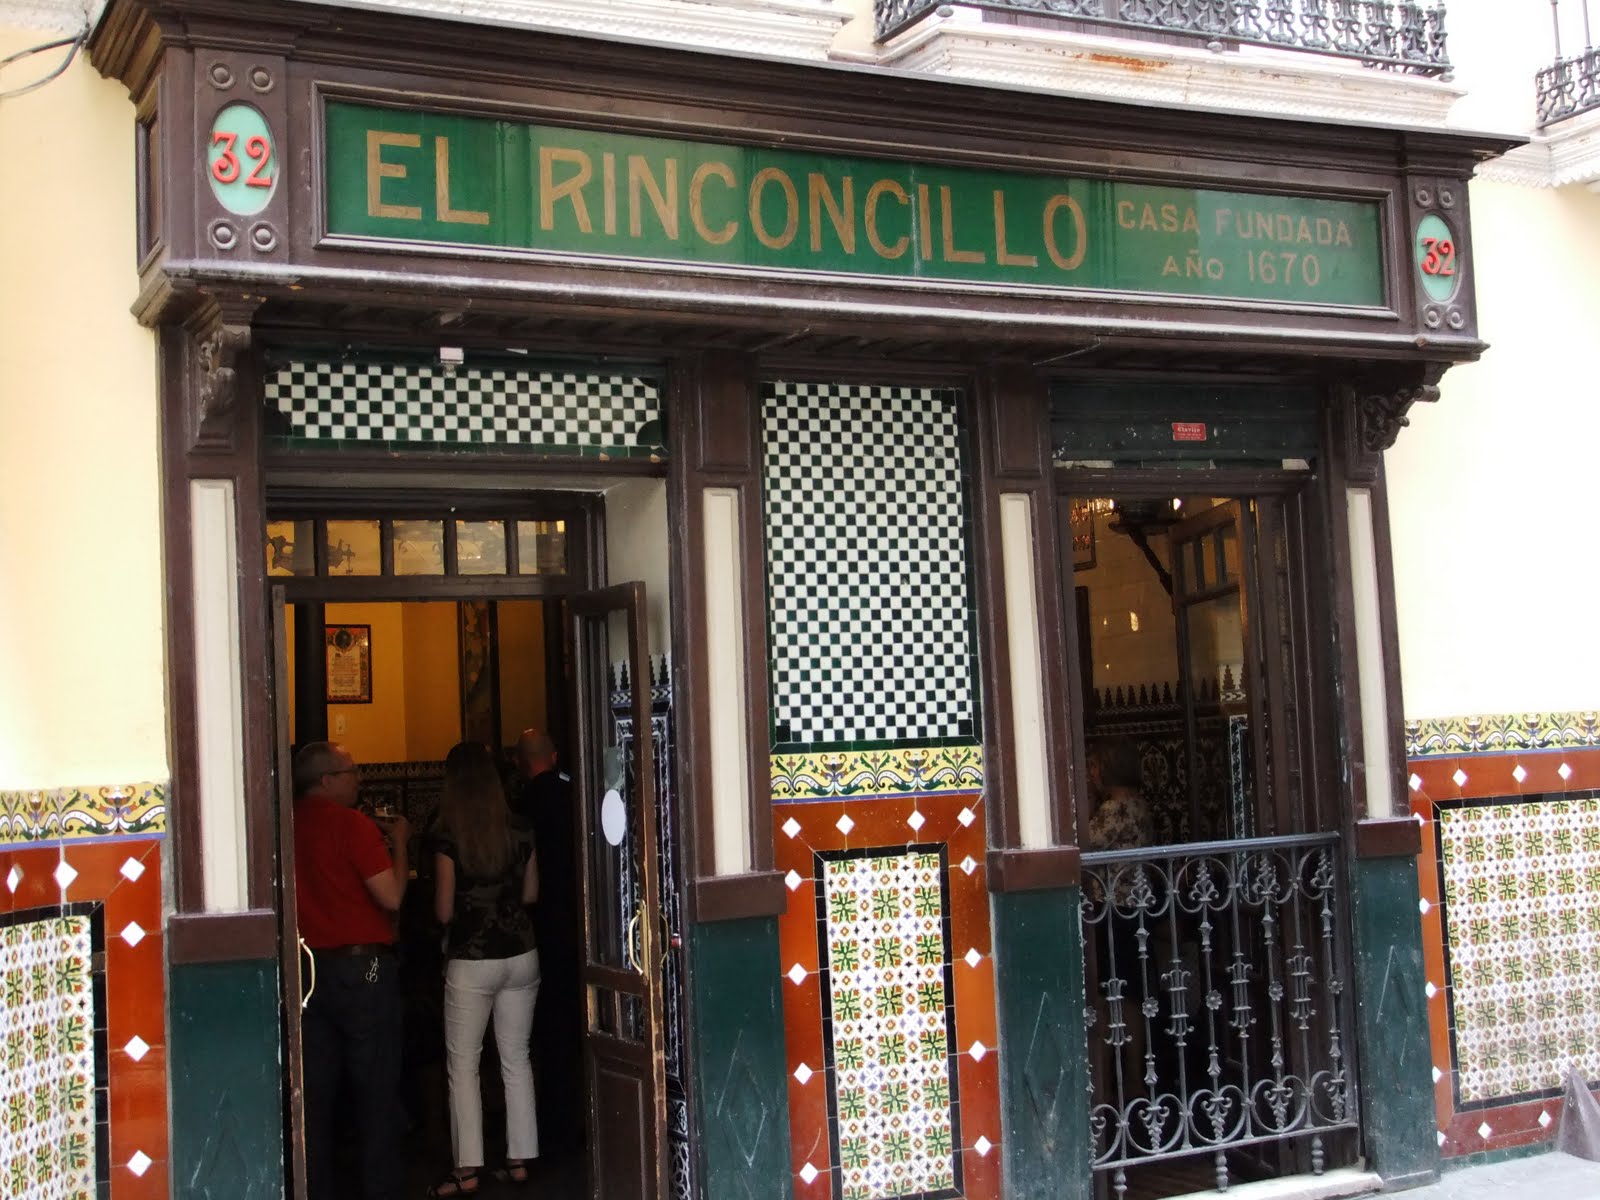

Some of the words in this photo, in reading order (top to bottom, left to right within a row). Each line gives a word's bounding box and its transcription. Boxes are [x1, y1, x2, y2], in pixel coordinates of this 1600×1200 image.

[211, 131, 273, 188] 32
[366, 130, 490, 225] EL
[539, 146, 1087, 271] RINCONCILLO
[1117, 201, 1201, 234] CASA
[1214, 208, 1353, 247] FUNDADA
[1161, 250, 1225, 281] AÑO
[1248, 251, 1321, 287] 1670
[1421, 237, 1456, 276] 32
